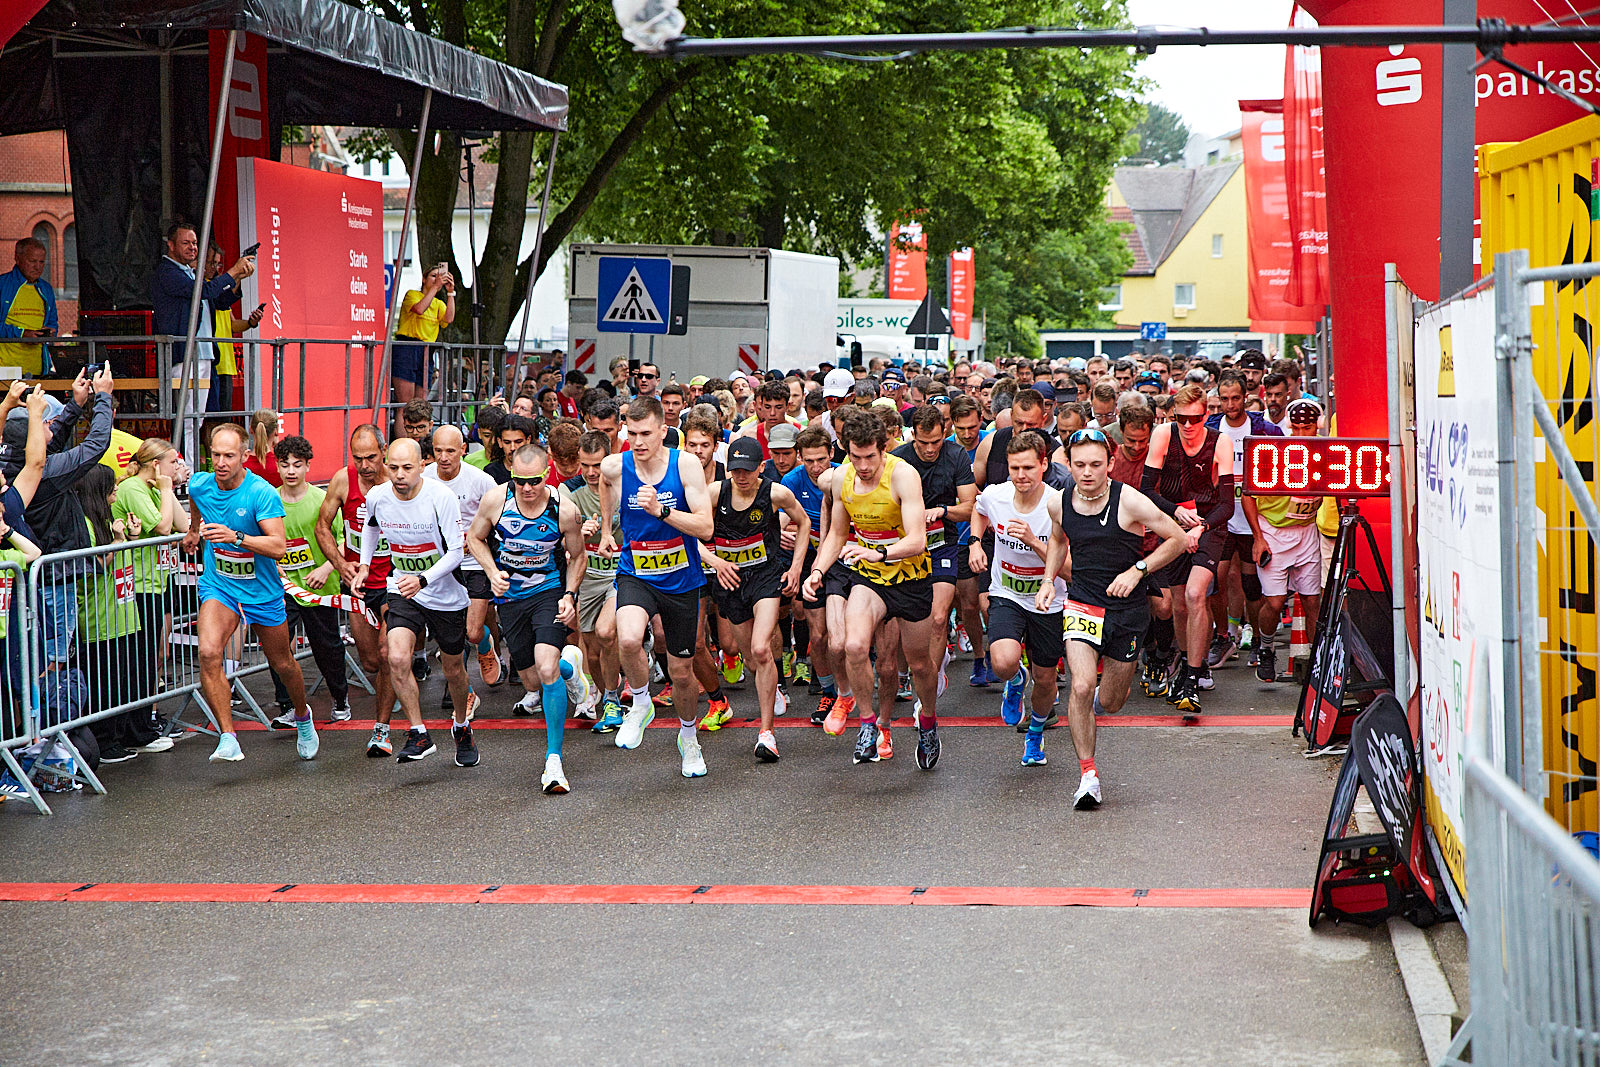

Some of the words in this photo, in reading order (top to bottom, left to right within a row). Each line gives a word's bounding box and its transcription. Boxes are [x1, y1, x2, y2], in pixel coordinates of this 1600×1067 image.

[270, 206, 281, 290] richtig!
[350, 249, 368, 269] Starte
[351, 276, 368, 295] deine
[351, 303, 375, 322] Karriere
[279, 549, 308, 565] 366
[398, 555, 435, 572] 1001
[588, 555, 620, 571] 1195
[639, 551, 680, 569] 2147
[723, 546, 762, 563] 2716
[216, 558, 255, 575] 1310
[1063, 615, 1097, 636] 258
